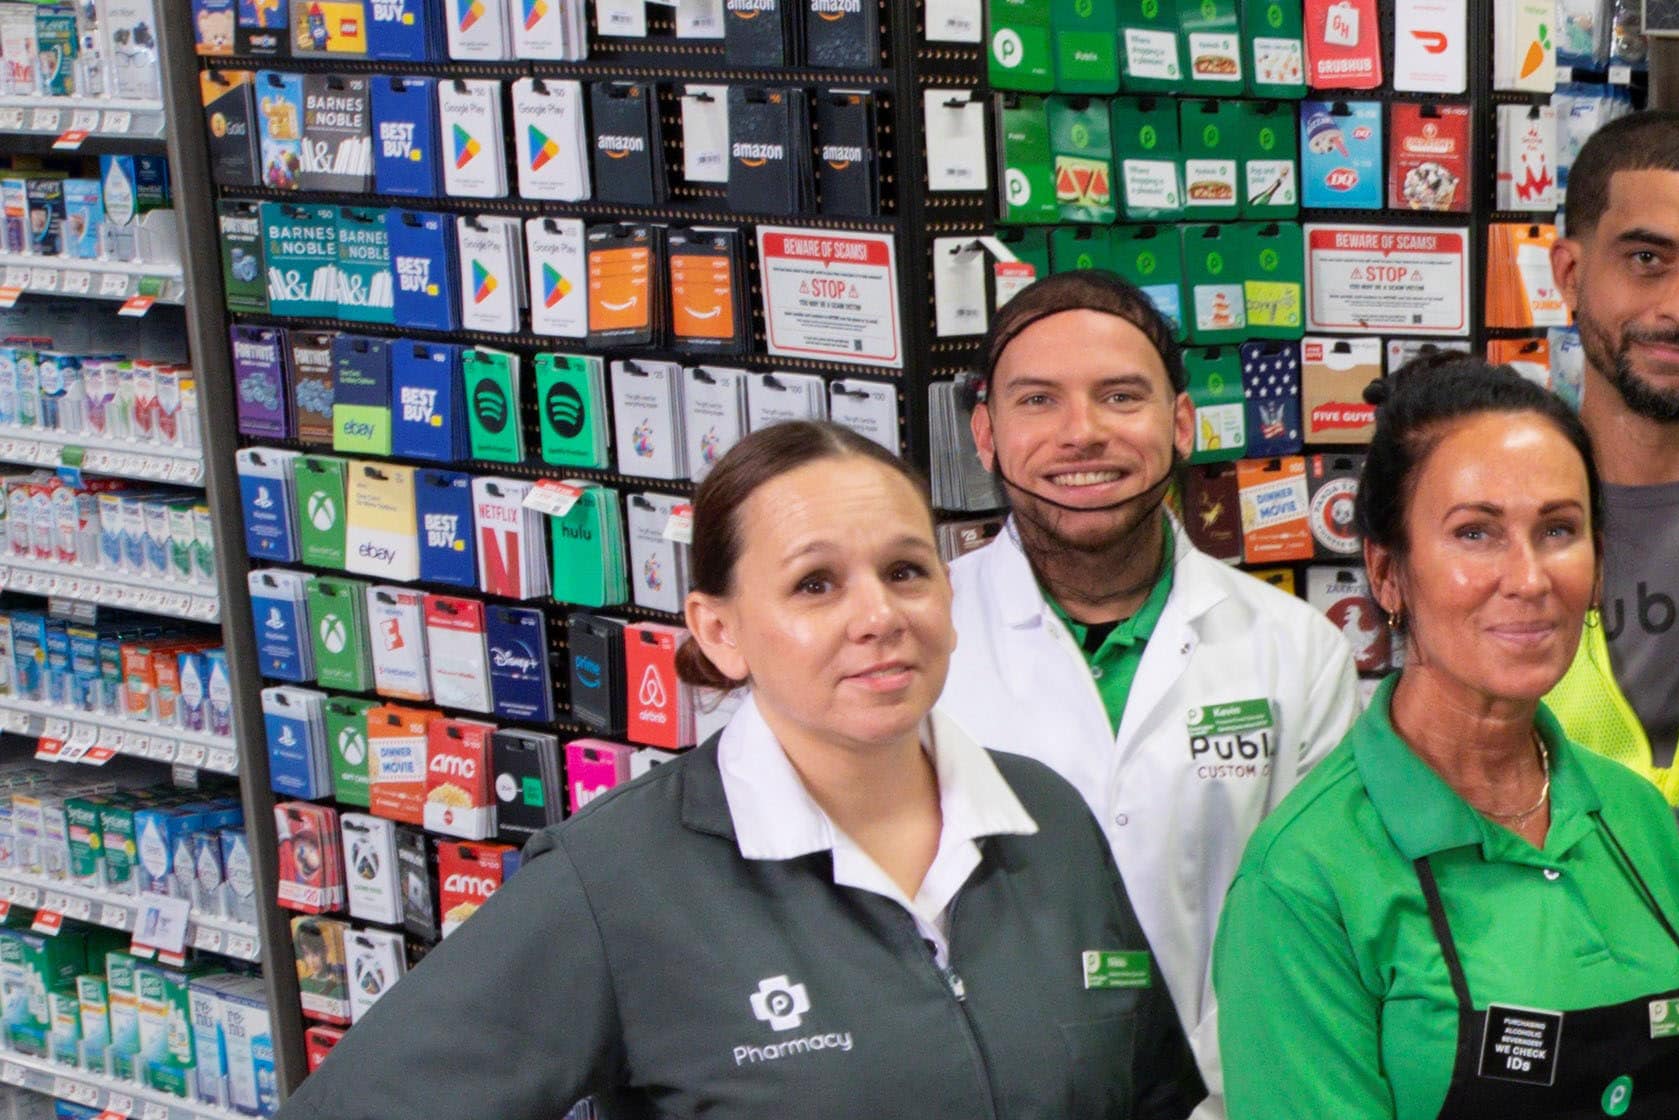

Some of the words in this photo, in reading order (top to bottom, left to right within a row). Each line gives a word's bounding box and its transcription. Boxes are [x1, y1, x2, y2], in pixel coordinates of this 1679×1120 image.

[373, 5, 404, 21] BUY
[1317, 58, 1373, 74] GRUBHUB
[306, 95, 364, 112] BARNES
[518, 102, 546, 116] Google
[315, 112, 363, 128] NOBLE
[379, 122, 416, 142] BEST
[383, 141, 413, 159] BUY
[598, 135, 644, 151] amazon
[732, 142, 784, 160] amazon
[822, 145, 862, 162] amazon
[1330, 172, 1355, 186] DQ
[269, 226, 336, 240] BARNES
[339, 229, 389, 245] BARNES
[1335, 233, 1378, 248] BEWARE
[1381, 234, 1394, 248] OF
[1396, 235, 1437, 250] SCAMS!
[282, 242, 337, 256] NOBLE
[349, 246, 390, 261] NOBLE
[783, 238, 820, 256] BEWARE
[821, 241, 833, 258] OF
[833, 242, 868, 261] SCAMS!
[396, 257, 431, 275] BEST
[1366, 266, 1408, 282] STOP
[401, 275, 430, 293] BUY
[811, 278, 846, 299] STOP
[401, 387, 438, 407] BEST
[403, 404, 433, 423] BUY
[1312, 411, 1340, 423] FIVE
[1342, 411, 1376, 423] GUYS
[343, 420, 375, 440] ebay
[1256, 487, 1294, 506] DINNER
[478, 503, 519, 525] NETFLIX
[1259, 500, 1297, 519] MOVIE
[424, 513, 458, 531] BEST
[428, 530, 456, 549] BUY
[562, 524, 593, 541] hulu
[358, 541, 396, 565] ebay
[490, 646, 539, 674] Disney+
[639, 710, 668, 724] airbnb
[382, 760, 415, 773] MOVIE
[429, 753, 477, 779] amc
[1197, 765, 1256, 780] CUSTOM
[444, 873, 497, 897] amc
[732, 1029, 853, 1067] Pharmacy
[1495, 1042, 1512, 1054] WE
[1512, 1046, 1548, 1059] CHECK
[1506, 1055, 1532, 1072] IDs
